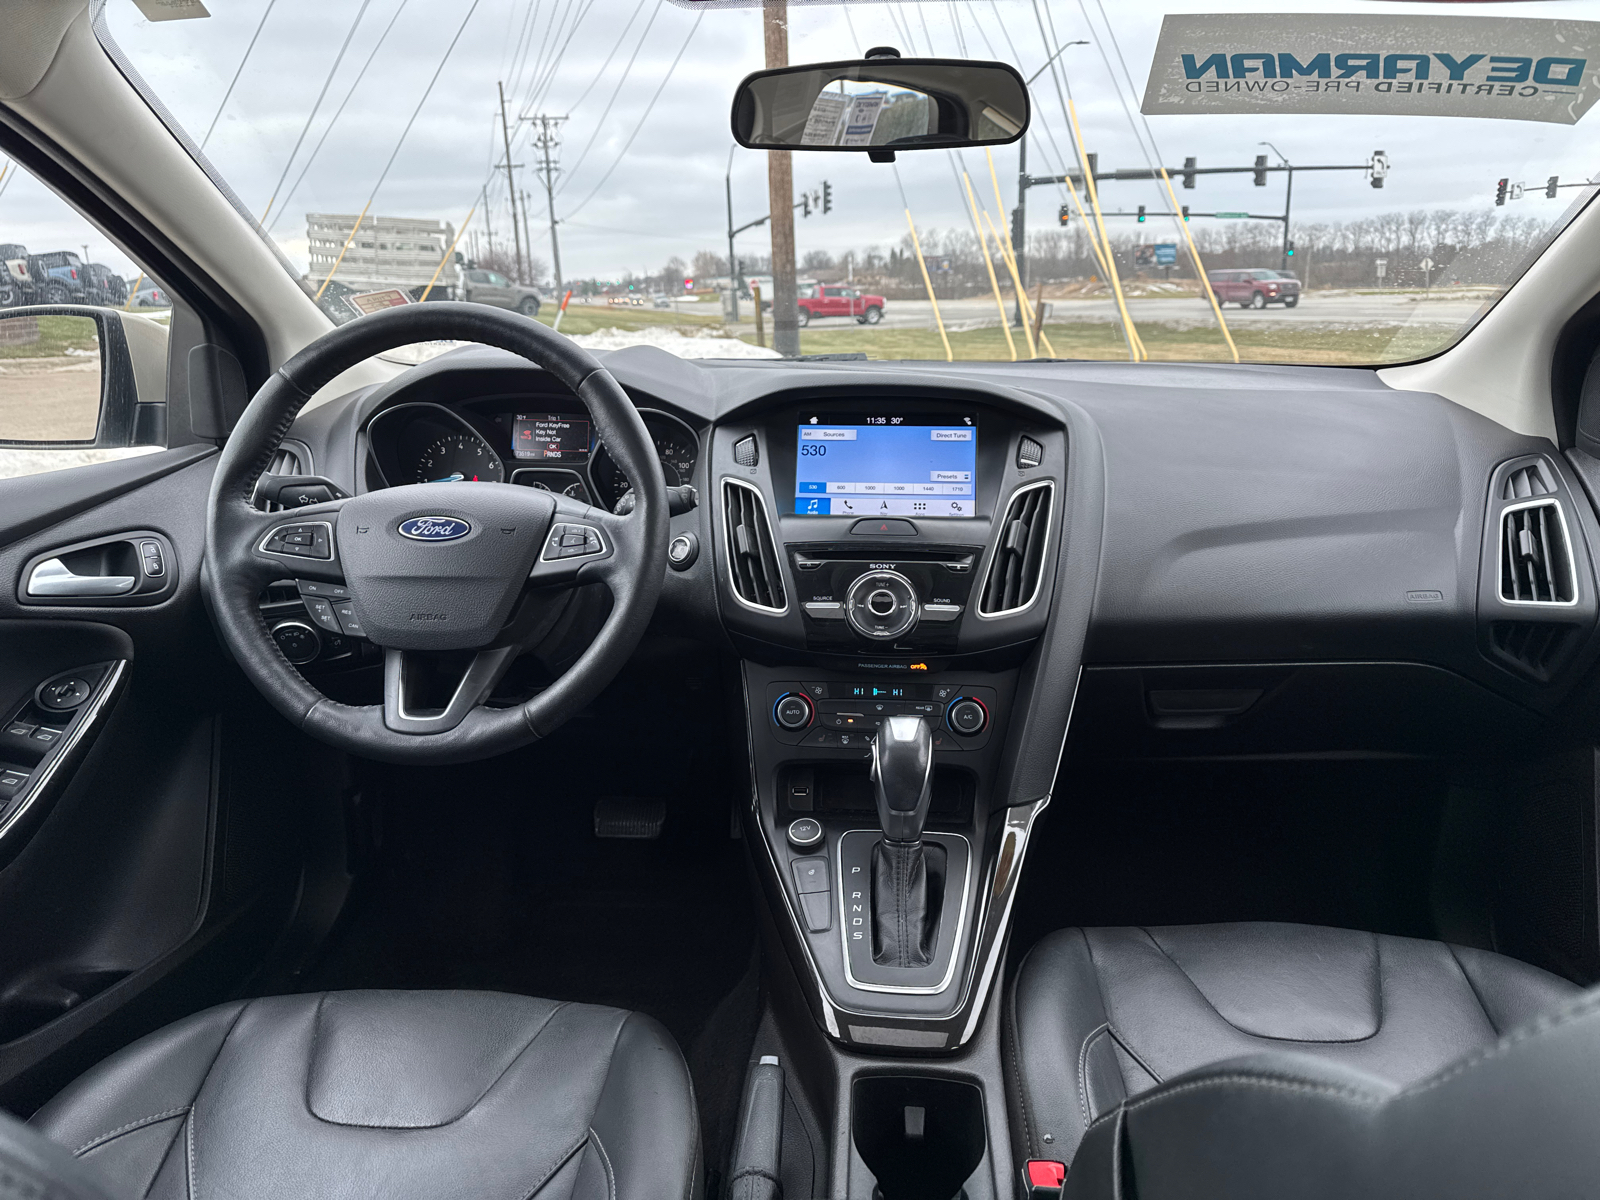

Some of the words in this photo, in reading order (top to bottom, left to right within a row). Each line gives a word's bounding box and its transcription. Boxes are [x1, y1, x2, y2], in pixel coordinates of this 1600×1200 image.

[866, 417, 886, 425] 11:35
[890, 417, 904, 425] 30°
[458, 442, 464, 450] 4
[440, 446, 446, 455] 3
[477, 448, 482, 456] 5
[665, 448, 674, 456] 80
[801, 444, 827, 457] 530
[427, 459, 433, 468] 2
[488, 461, 494, 470] 6
[620, 481, 628, 489] 20
[411, 518, 456, 535] Ford
[410, 613, 447, 621] AIRBAG
[852, 891, 861, 899] R
[853, 904, 862, 912] N
[853, 917, 863, 926] D
[852, 931, 863, 940] S
